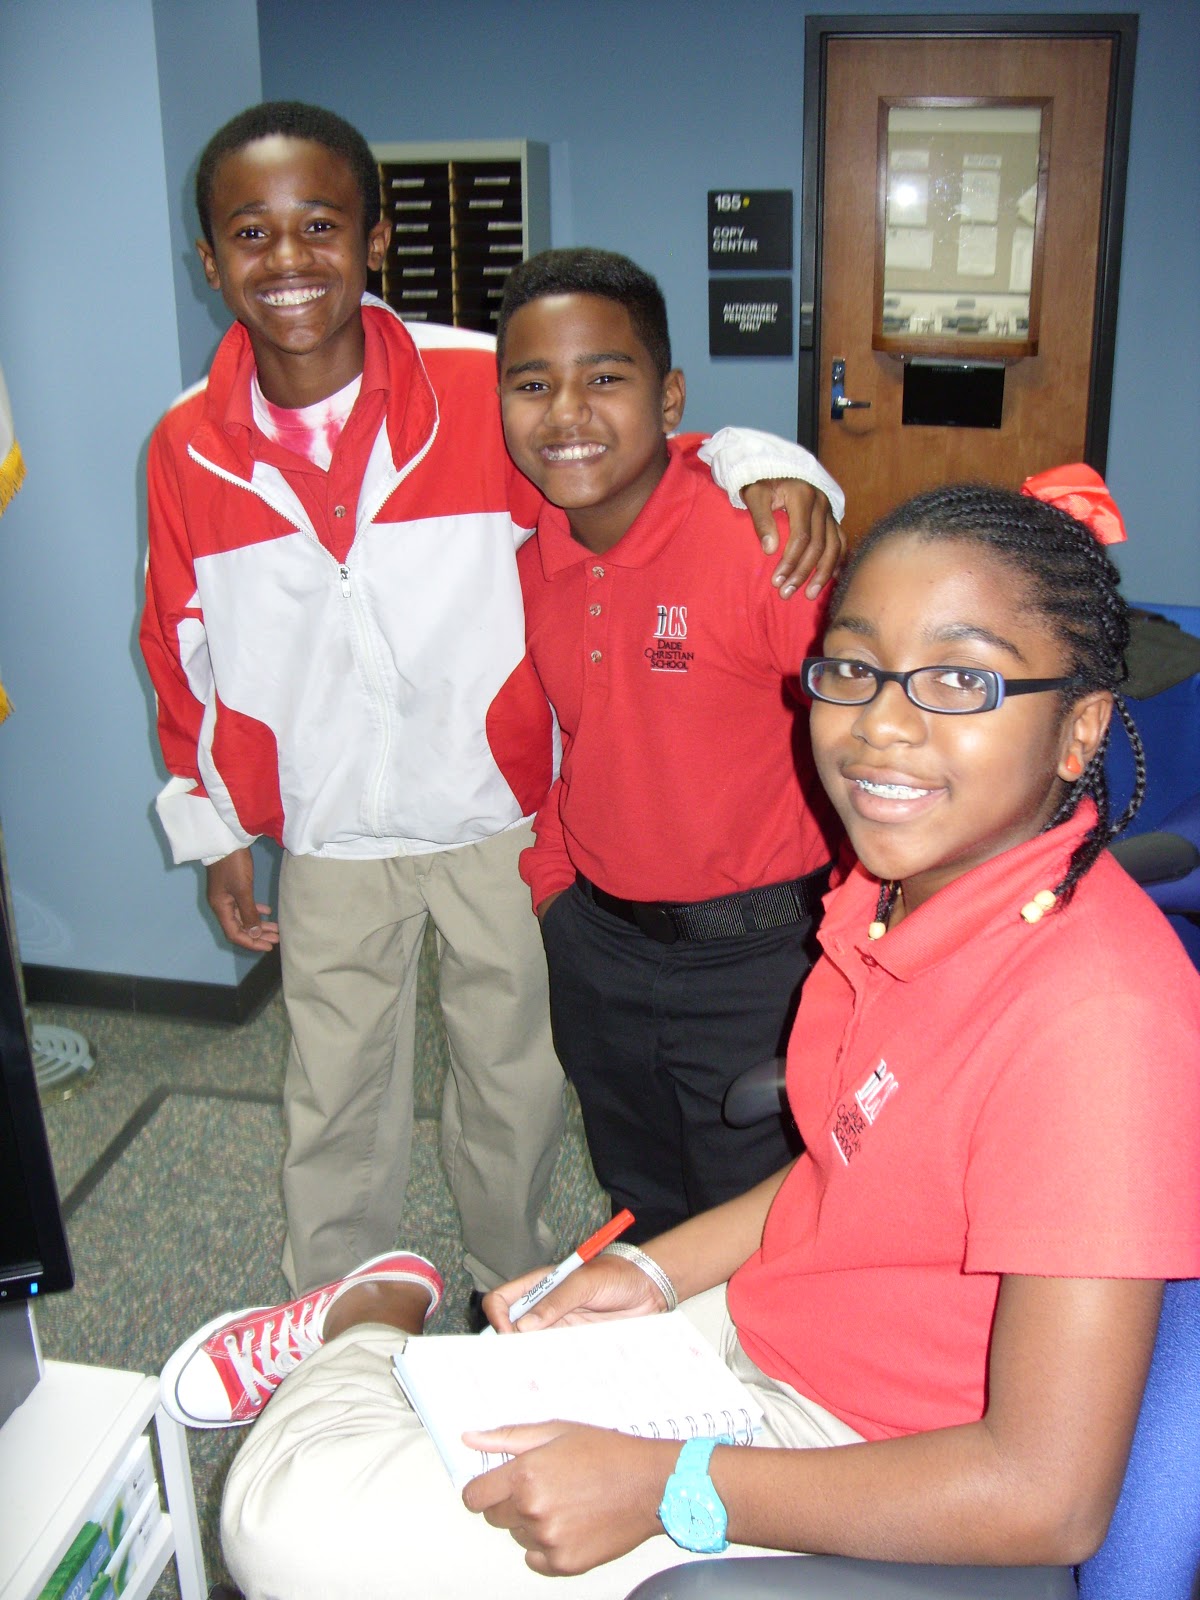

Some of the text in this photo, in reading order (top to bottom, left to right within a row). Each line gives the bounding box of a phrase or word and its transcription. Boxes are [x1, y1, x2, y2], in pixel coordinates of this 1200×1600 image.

[712, 225, 745, 240] COPY
[712, 238, 759, 253] CENTER
[723, 302, 778, 314] AUTHORIZED
[723, 313, 777, 324] PERSONNEL
[739, 321, 762, 333] ONLY
[654, 605, 688, 636] DCS
